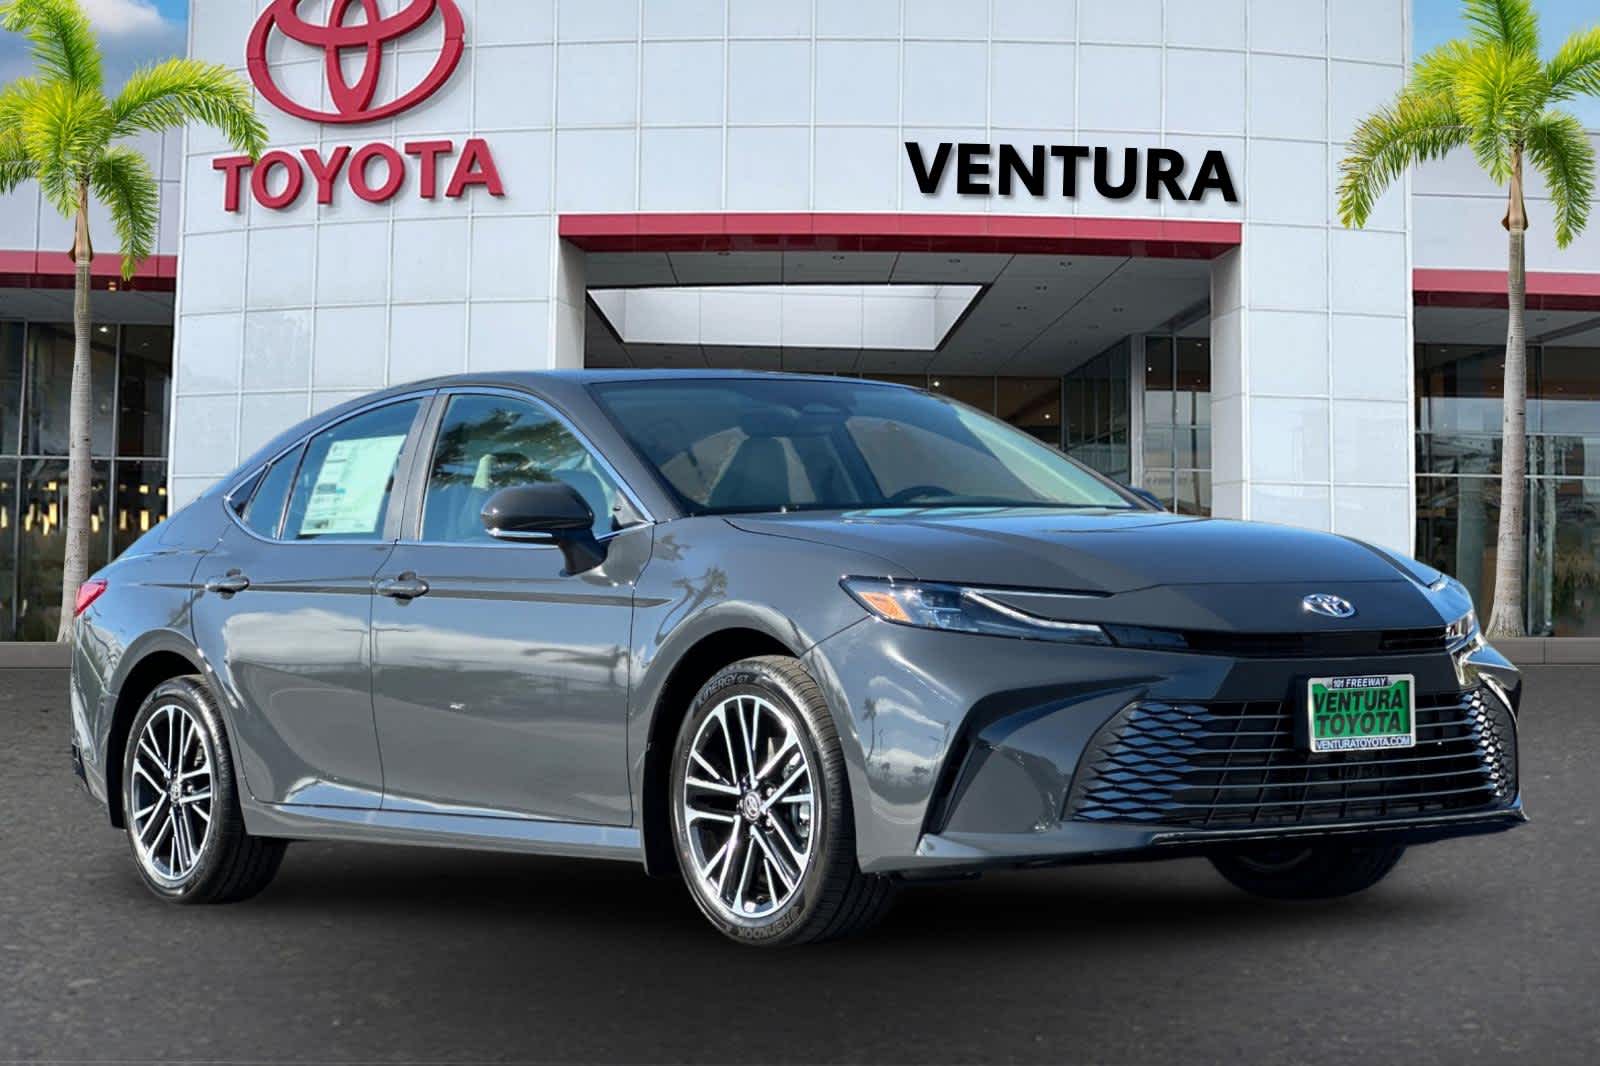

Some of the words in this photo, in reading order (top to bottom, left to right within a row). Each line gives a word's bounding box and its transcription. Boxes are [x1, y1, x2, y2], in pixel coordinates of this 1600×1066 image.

[212, 138, 505, 212] TOYOTA
[904, 141, 1239, 203] VENTURA
[1345, 677, 1386, 687] FREEWAY
[1313, 688, 1403, 714] VENTURA
[1316, 711, 1402, 736] TOYOTA
[1316, 736, 1410, 750] VENTURATOYOTA.COM
